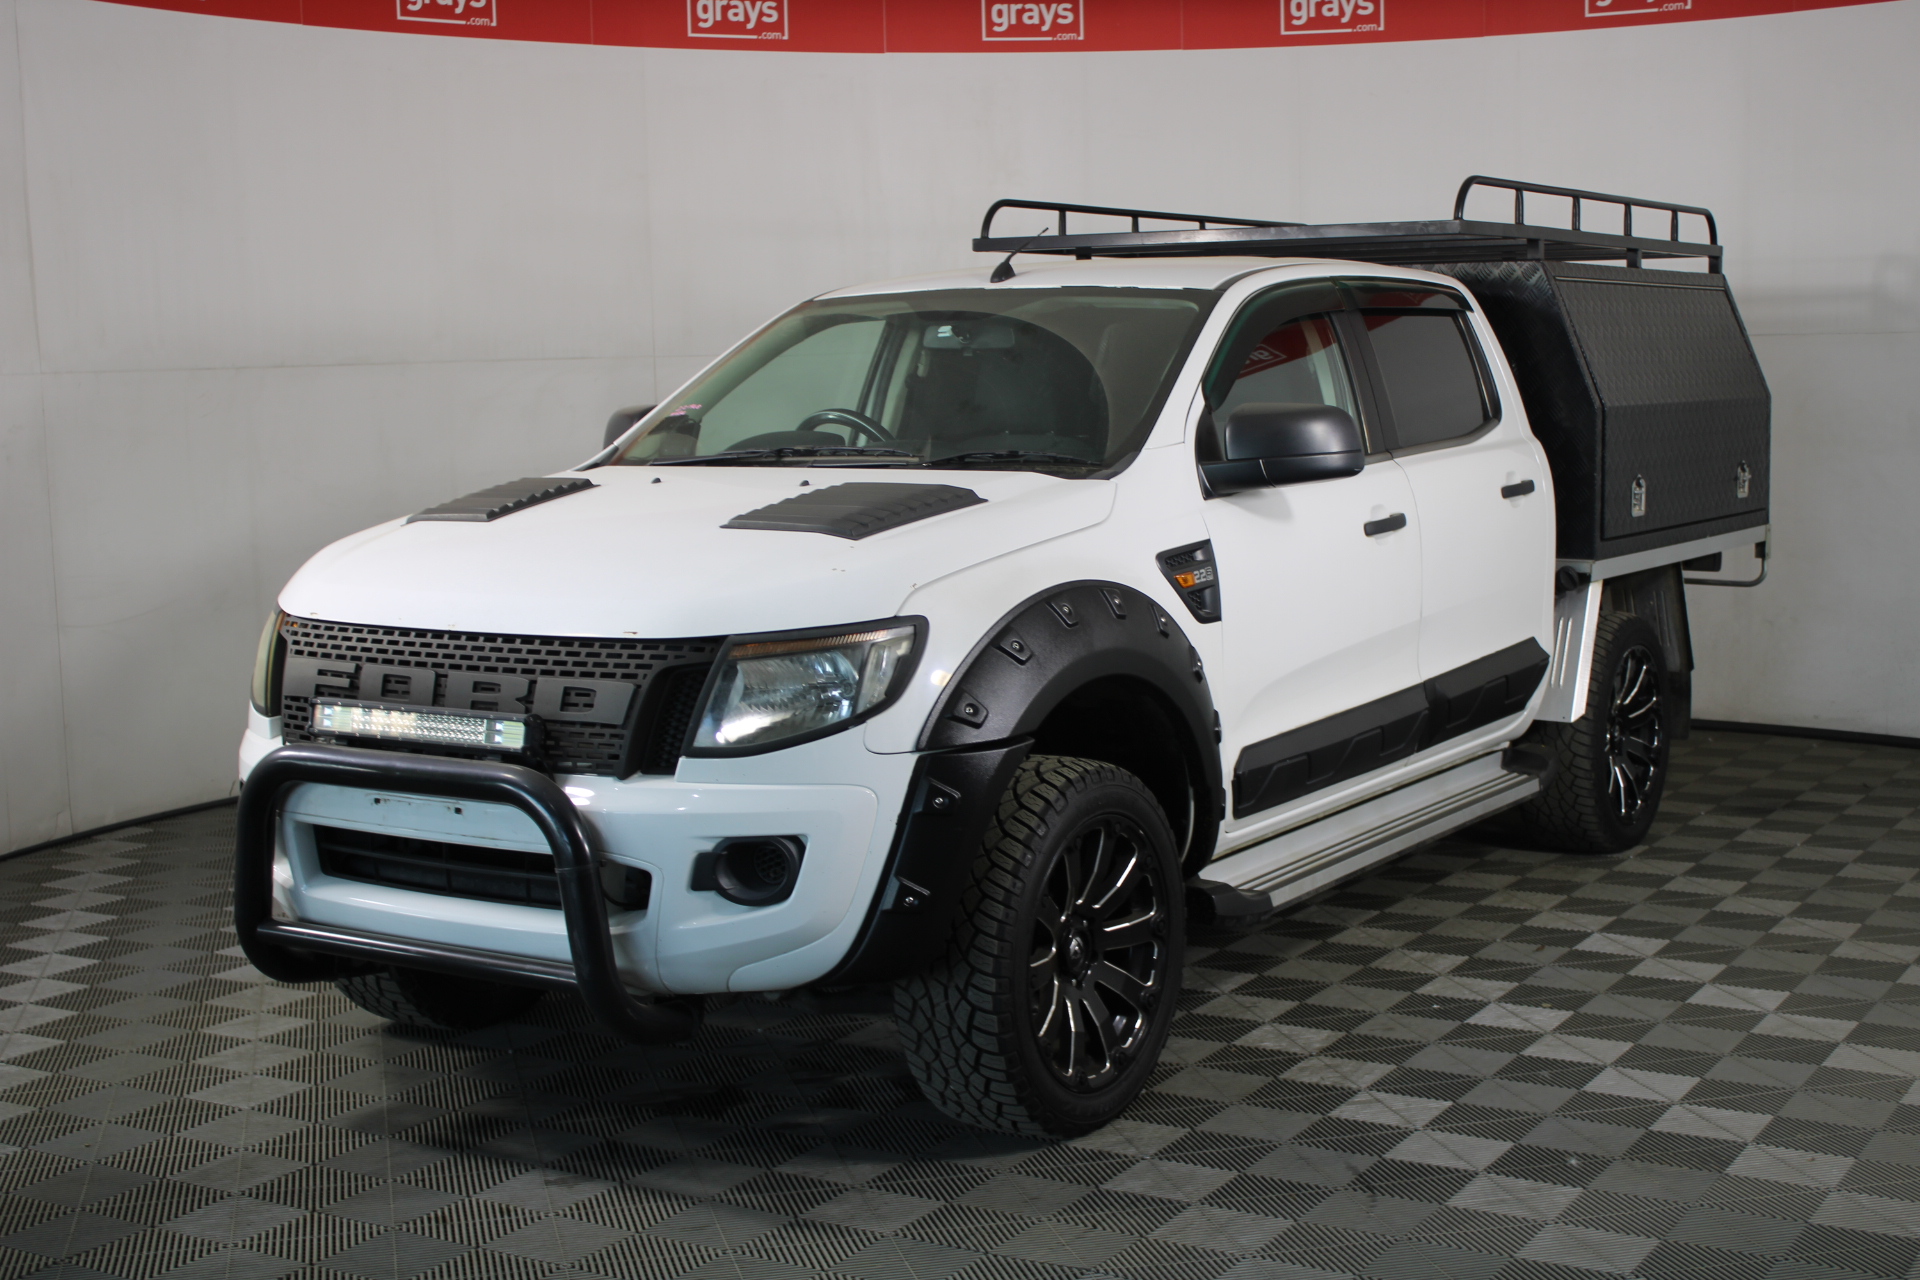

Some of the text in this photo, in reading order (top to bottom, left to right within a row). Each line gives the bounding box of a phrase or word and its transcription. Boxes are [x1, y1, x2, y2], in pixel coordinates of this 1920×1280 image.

[696, 0, 779, 29] grays
[991, 3, 1075, 32] grays
[1290, 0, 1375, 25] grays
[284, 656, 637, 725] FORD
